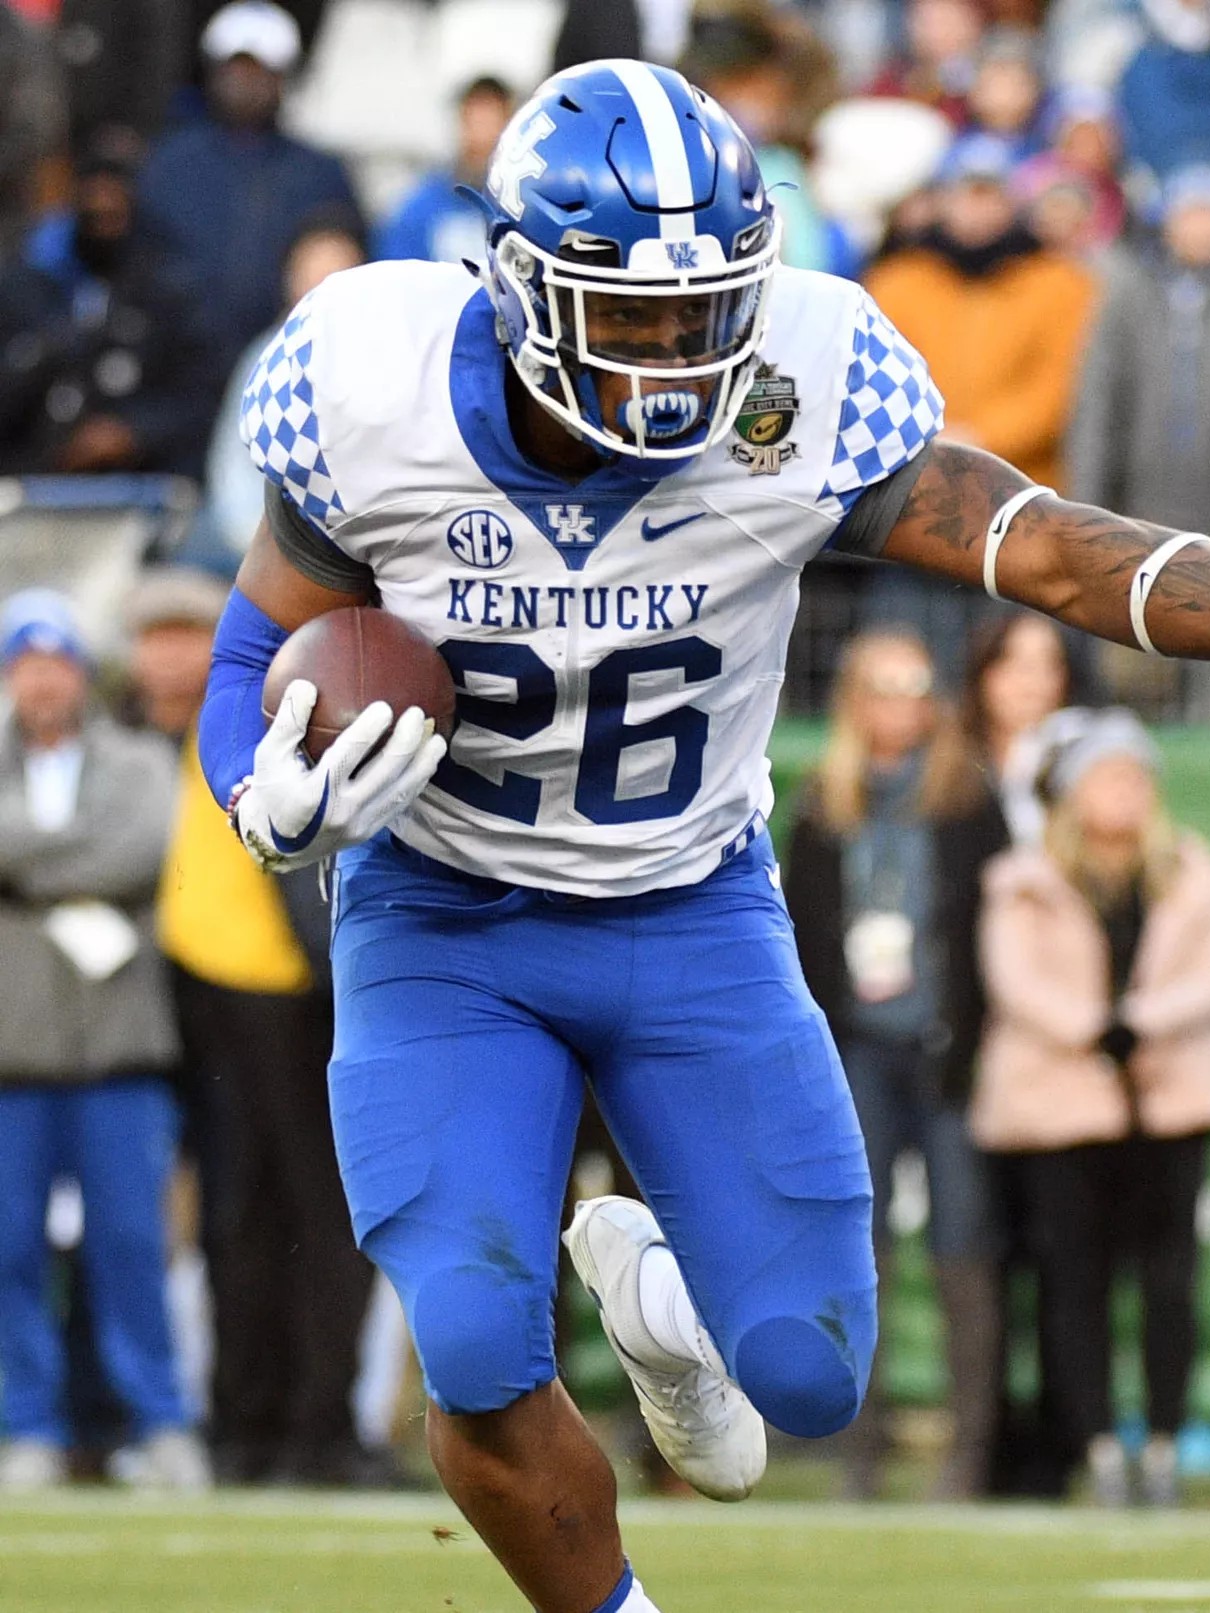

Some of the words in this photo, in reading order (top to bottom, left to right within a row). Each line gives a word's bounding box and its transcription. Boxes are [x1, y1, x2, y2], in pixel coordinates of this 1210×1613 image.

[665, 242, 698, 269] UK
[750, 447, 781, 477] 20
[448, 511, 511, 567] SEC
[545, 504, 596, 543] UK
[447, 578, 708, 630] KENTUCKY
[429, 635, 723, 828] 26
